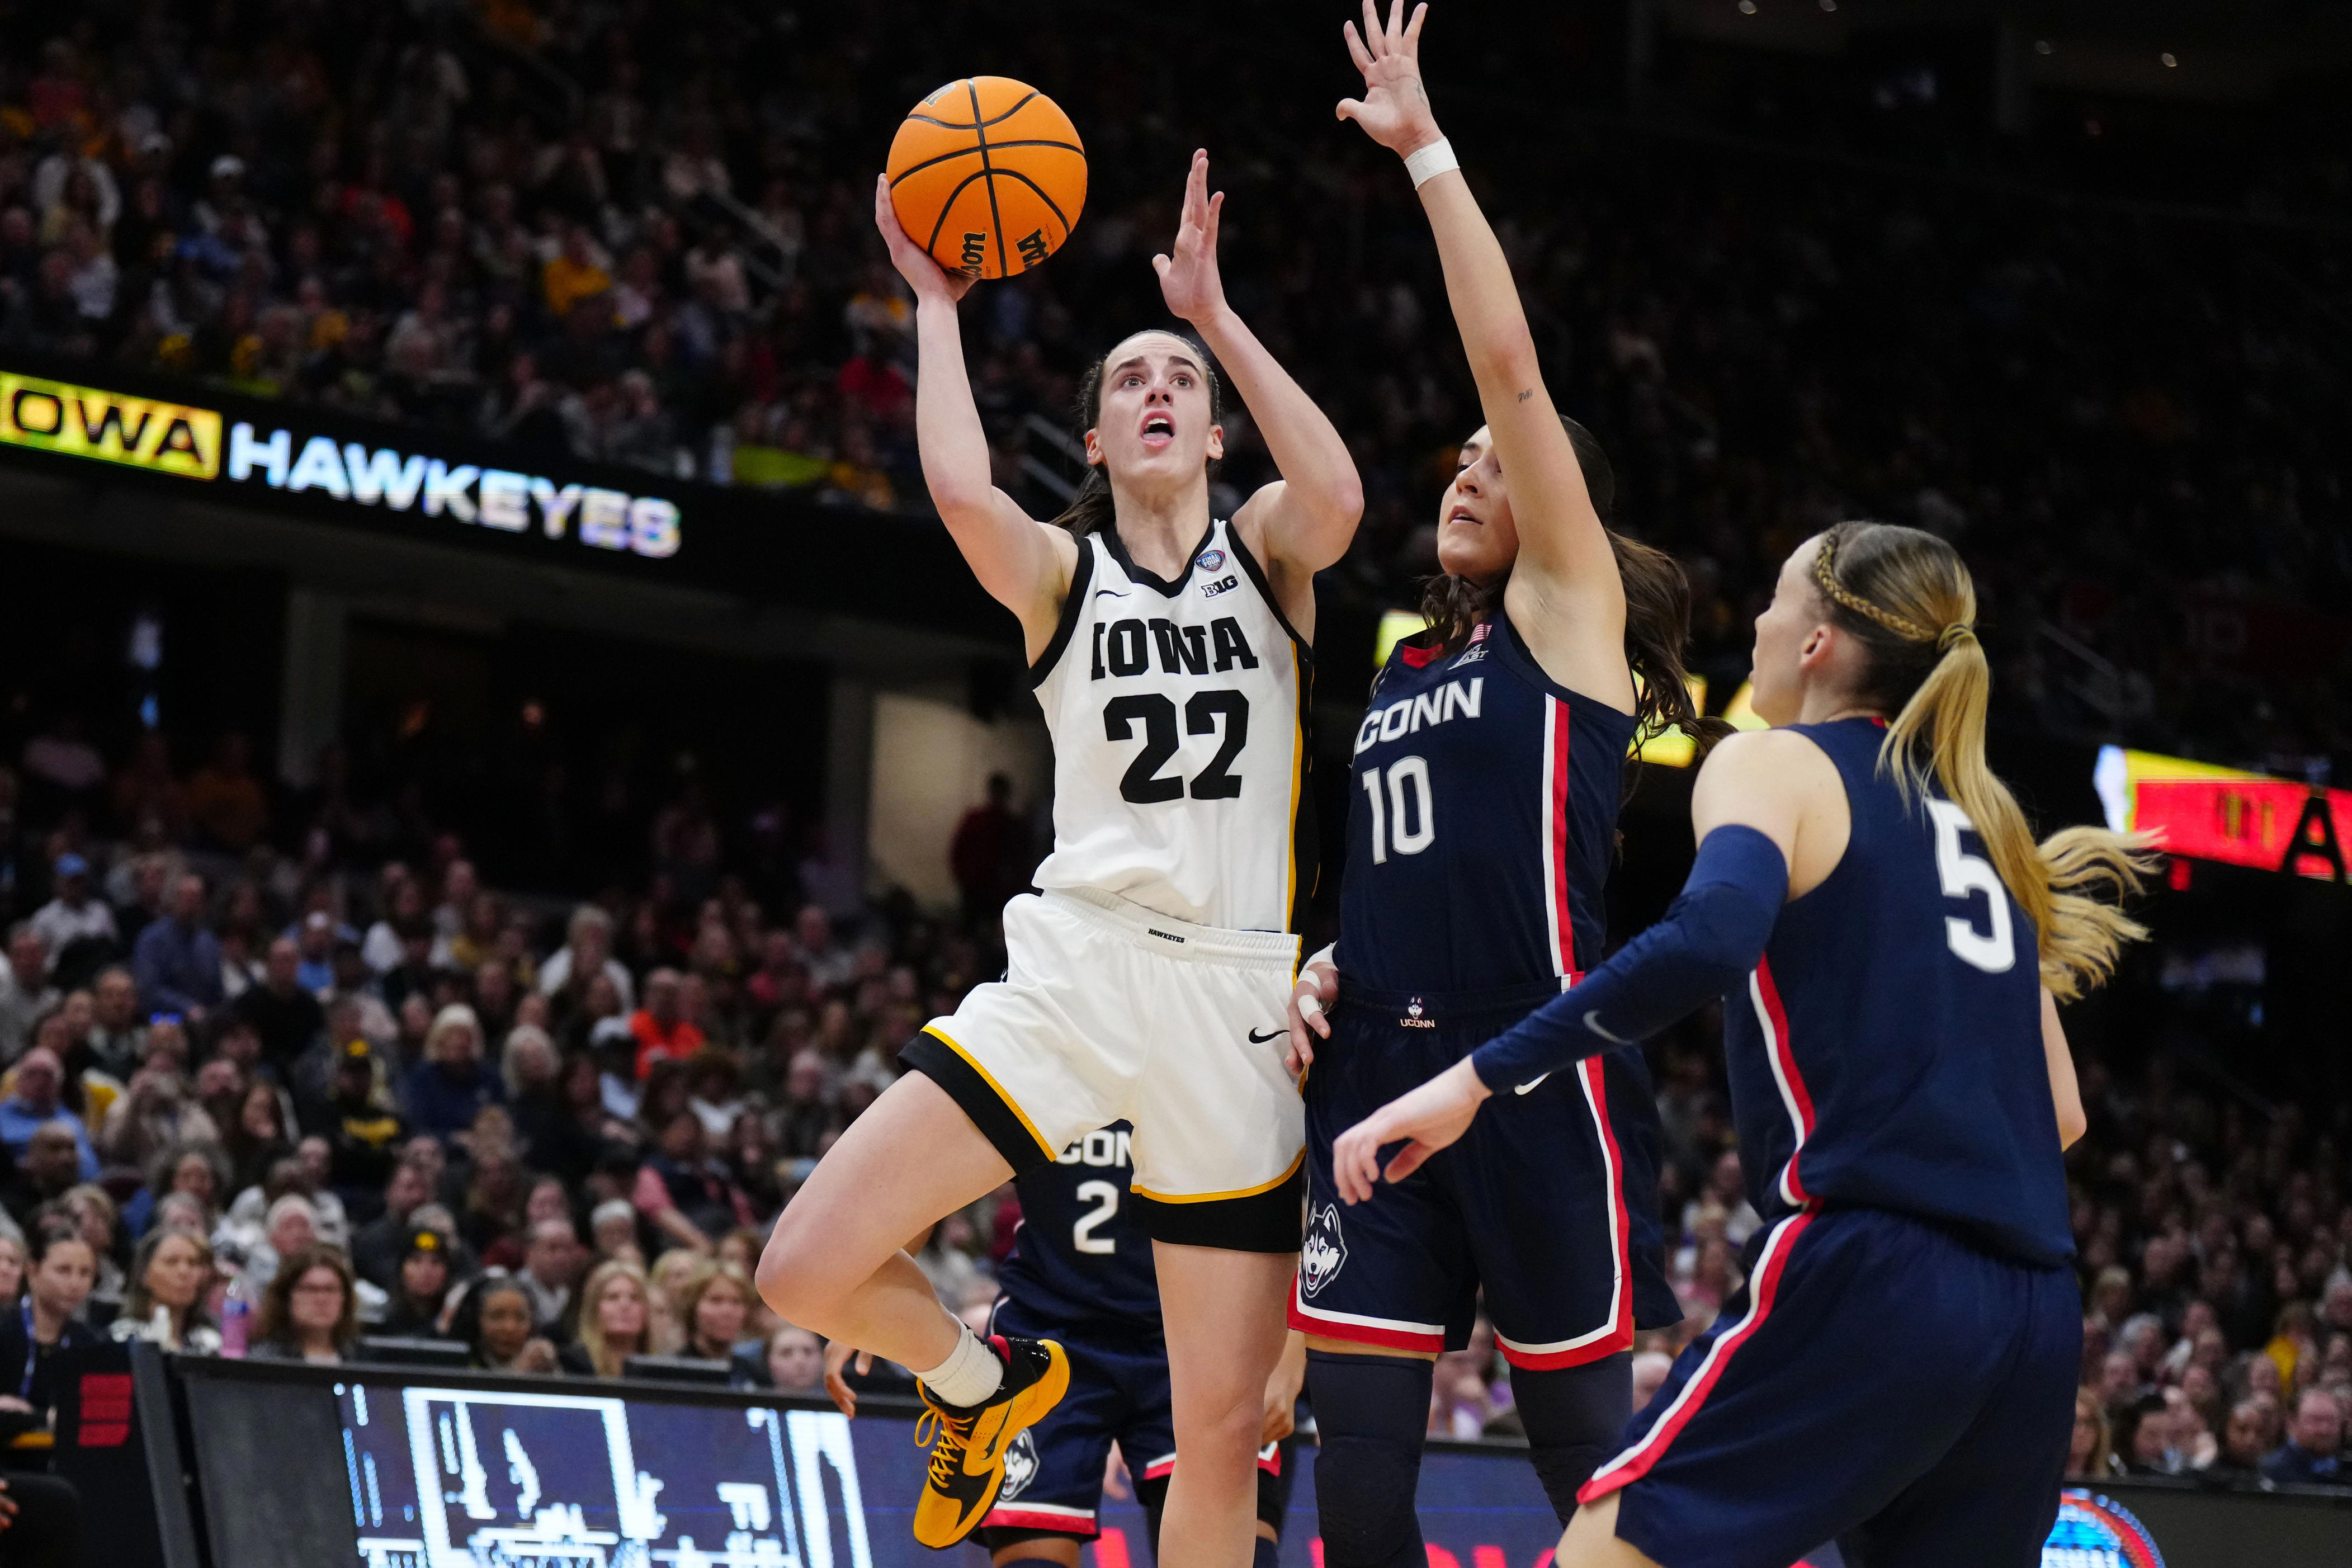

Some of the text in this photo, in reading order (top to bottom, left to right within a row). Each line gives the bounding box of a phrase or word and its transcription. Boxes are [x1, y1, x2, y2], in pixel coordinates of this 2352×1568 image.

[229, 422, 681, 558] HAWKEYES
[1202, 554, 1218, 562] FINAL
[1205, 558, 1221, 567] FOUR
[1091, 616, 1259, 681] IOWA
[1103, 689, 1249, 804] 22
[1362, 755, 1435, 866] 10
[1924, 799, 2016, 974] 5
[1147, 928, 1186, 943] HAWKEYES
[1400, 1018, 1435, 1028] UCONN
[1073, 1179, 1119, 1254] 2
